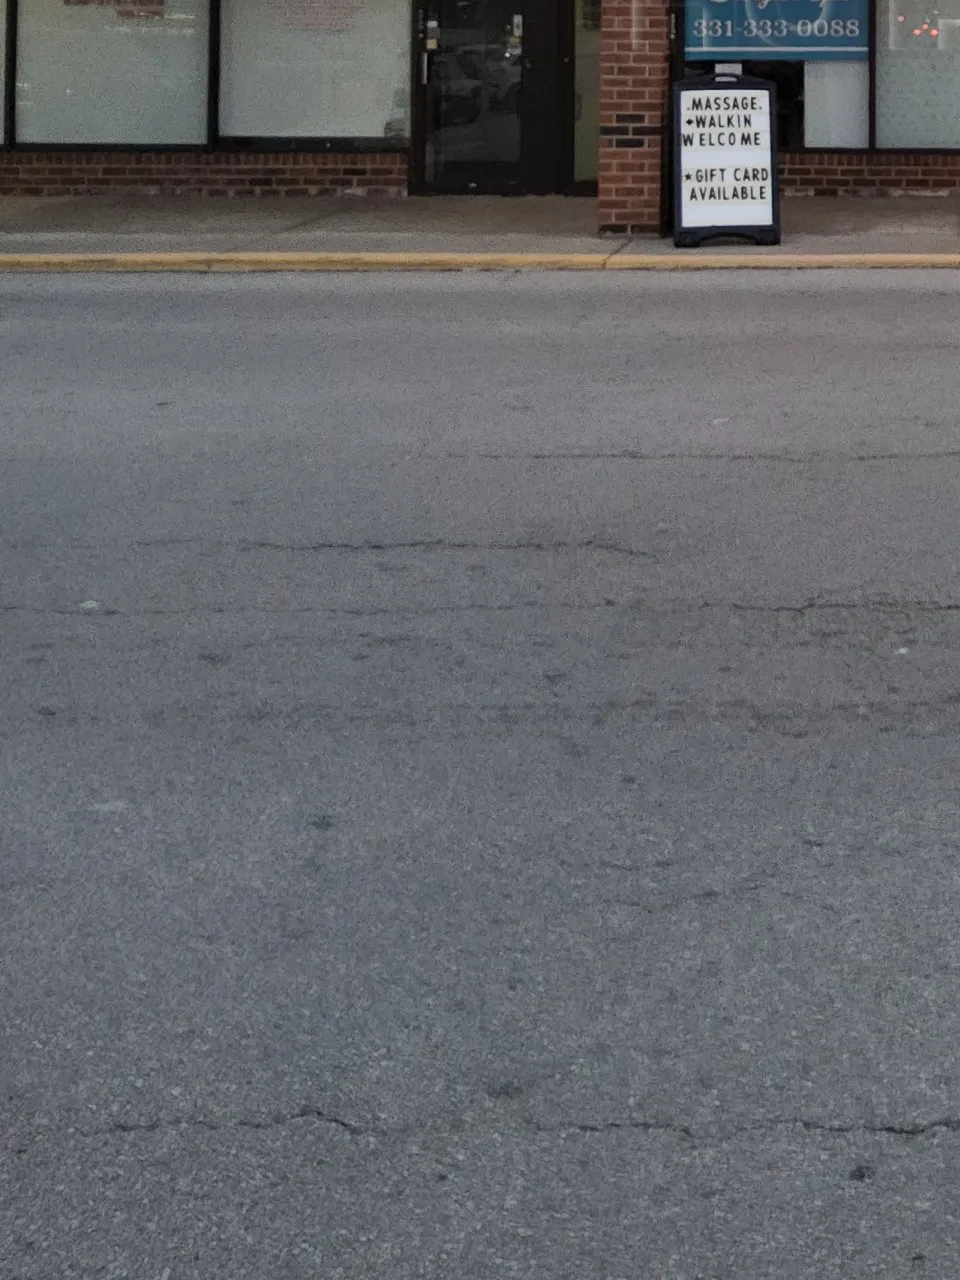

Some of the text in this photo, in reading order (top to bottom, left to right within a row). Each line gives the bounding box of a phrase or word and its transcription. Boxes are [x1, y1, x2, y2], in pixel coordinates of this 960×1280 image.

[693, 19, 860, 37] 331-333-0088
[683, 132, 761, 146] WELCOME
[696, 168, 768, 183] GIFT CARD
[690, 186, 766, 201] AVAILABLE
